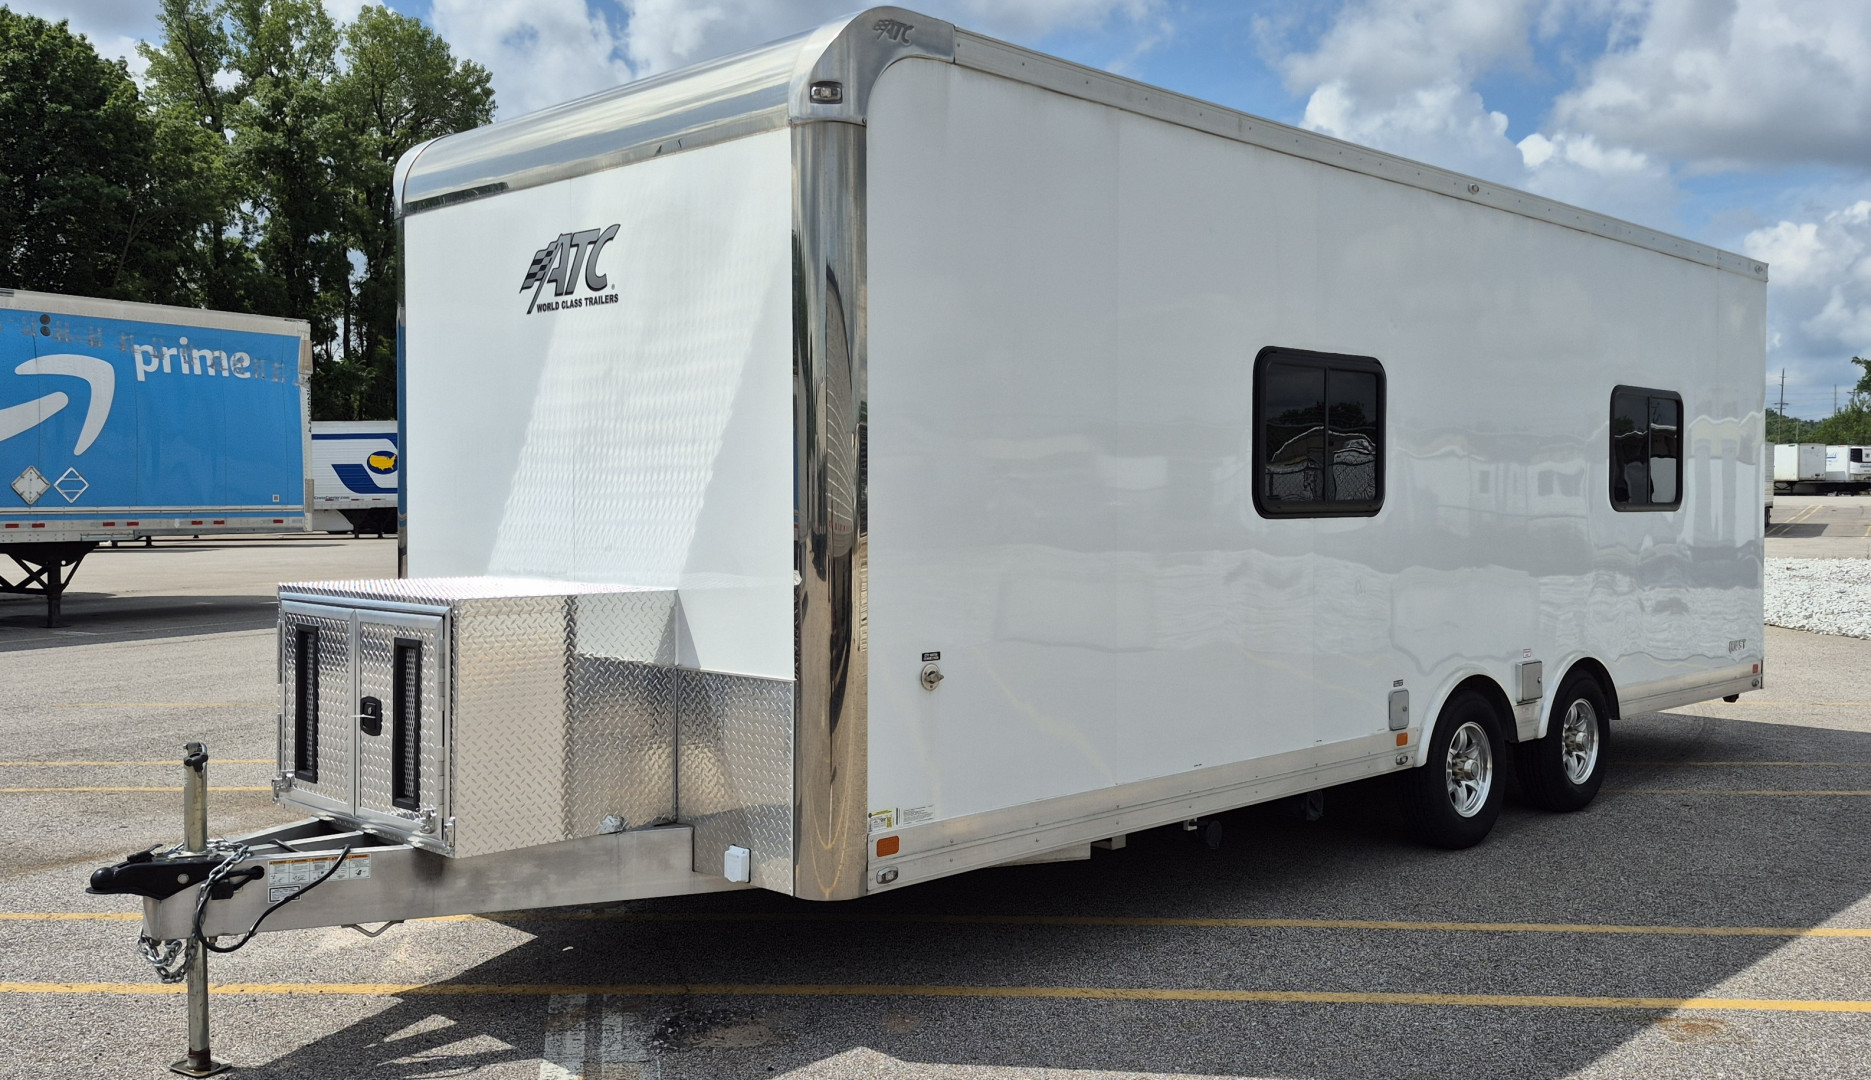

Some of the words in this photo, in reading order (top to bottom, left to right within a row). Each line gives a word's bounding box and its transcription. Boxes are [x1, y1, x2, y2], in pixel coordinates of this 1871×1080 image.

[877, 19, 914, 45] ATC
[528, 223, 621, 314] ATC
[536, 301, 560, 313] WORLD
[561, 298, 583, 309] CLASS
[584, 293, 619, 307] TRAILERS
[133, 336, 251, 381] prime
